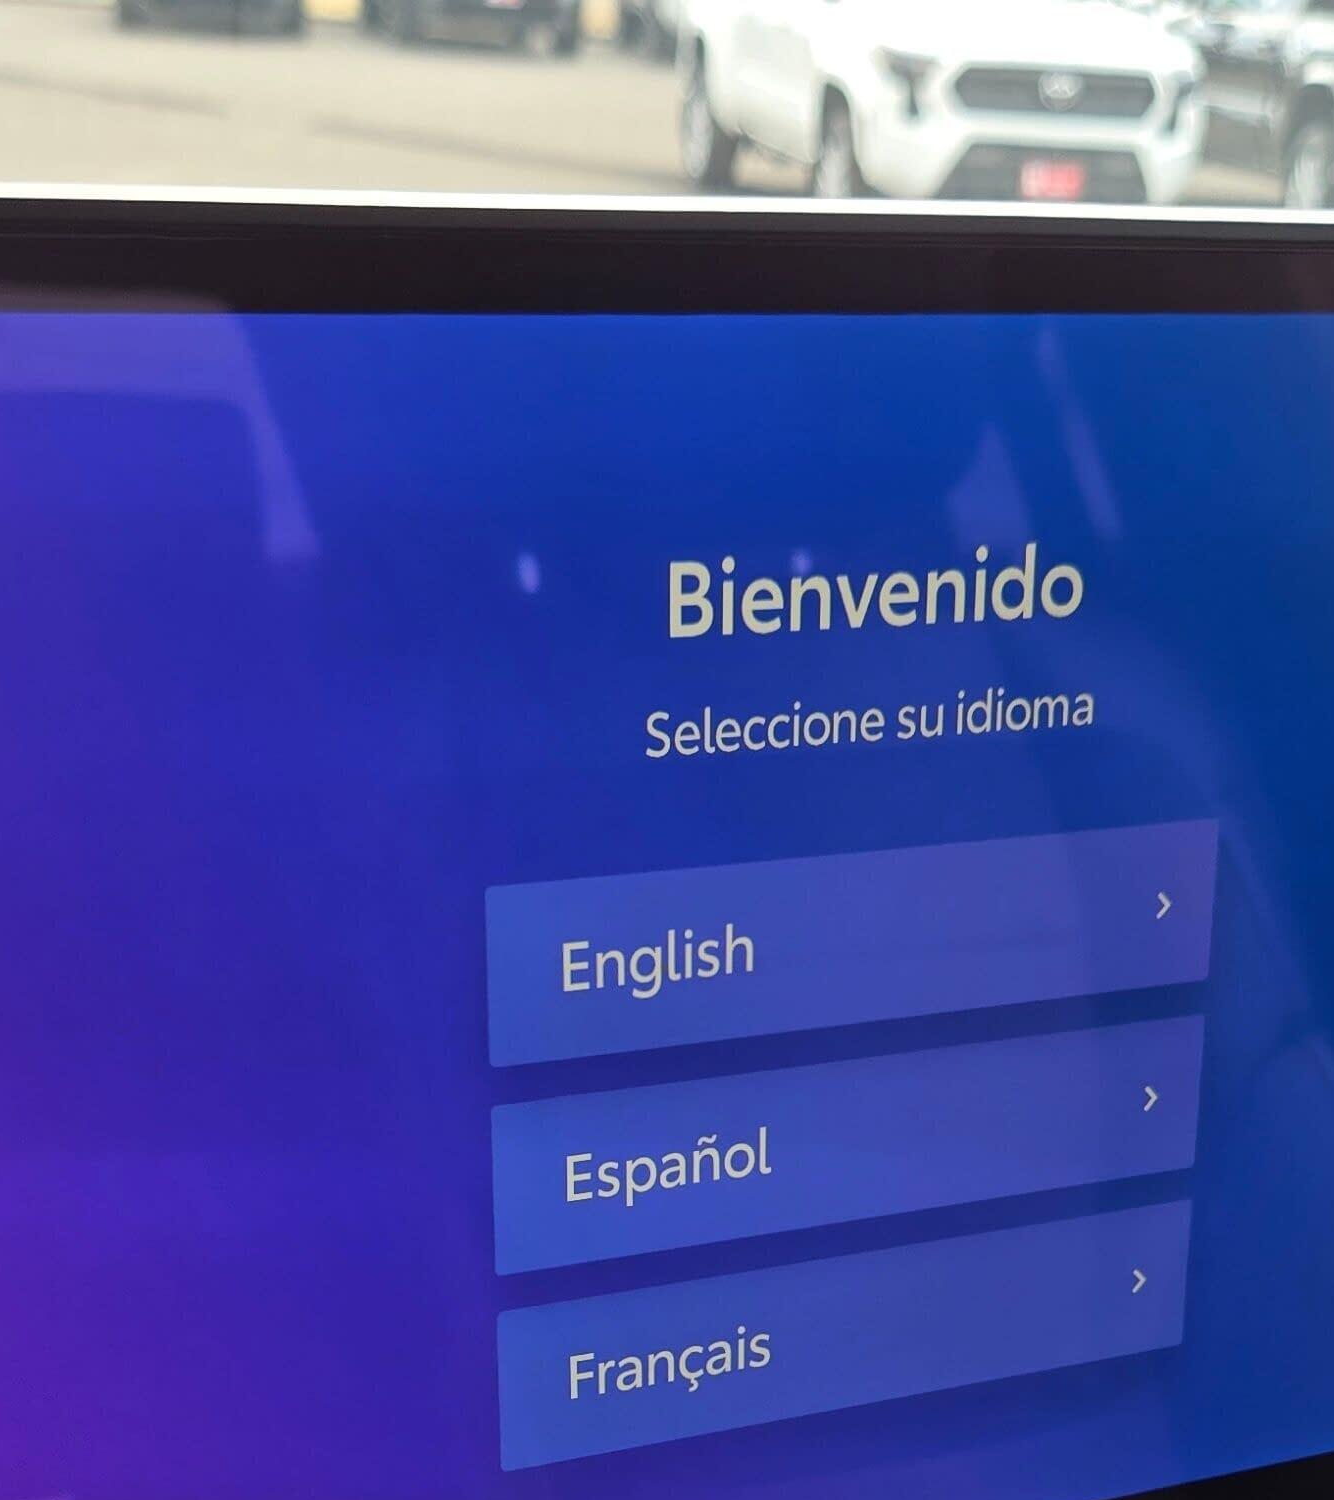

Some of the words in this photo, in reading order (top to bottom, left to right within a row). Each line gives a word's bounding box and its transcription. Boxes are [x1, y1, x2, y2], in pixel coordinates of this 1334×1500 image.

[669, 542, 1084, 639] Bienvenido
[645, 700, 886, 758] Seleccione
[896, 703, 944, 740] su
[956, 687, 1095, 735] idioma
[562, 923, 754, 999] English
[565, 1126, 772, 1207] Español
[569, 1325, 771, 1400] Français
